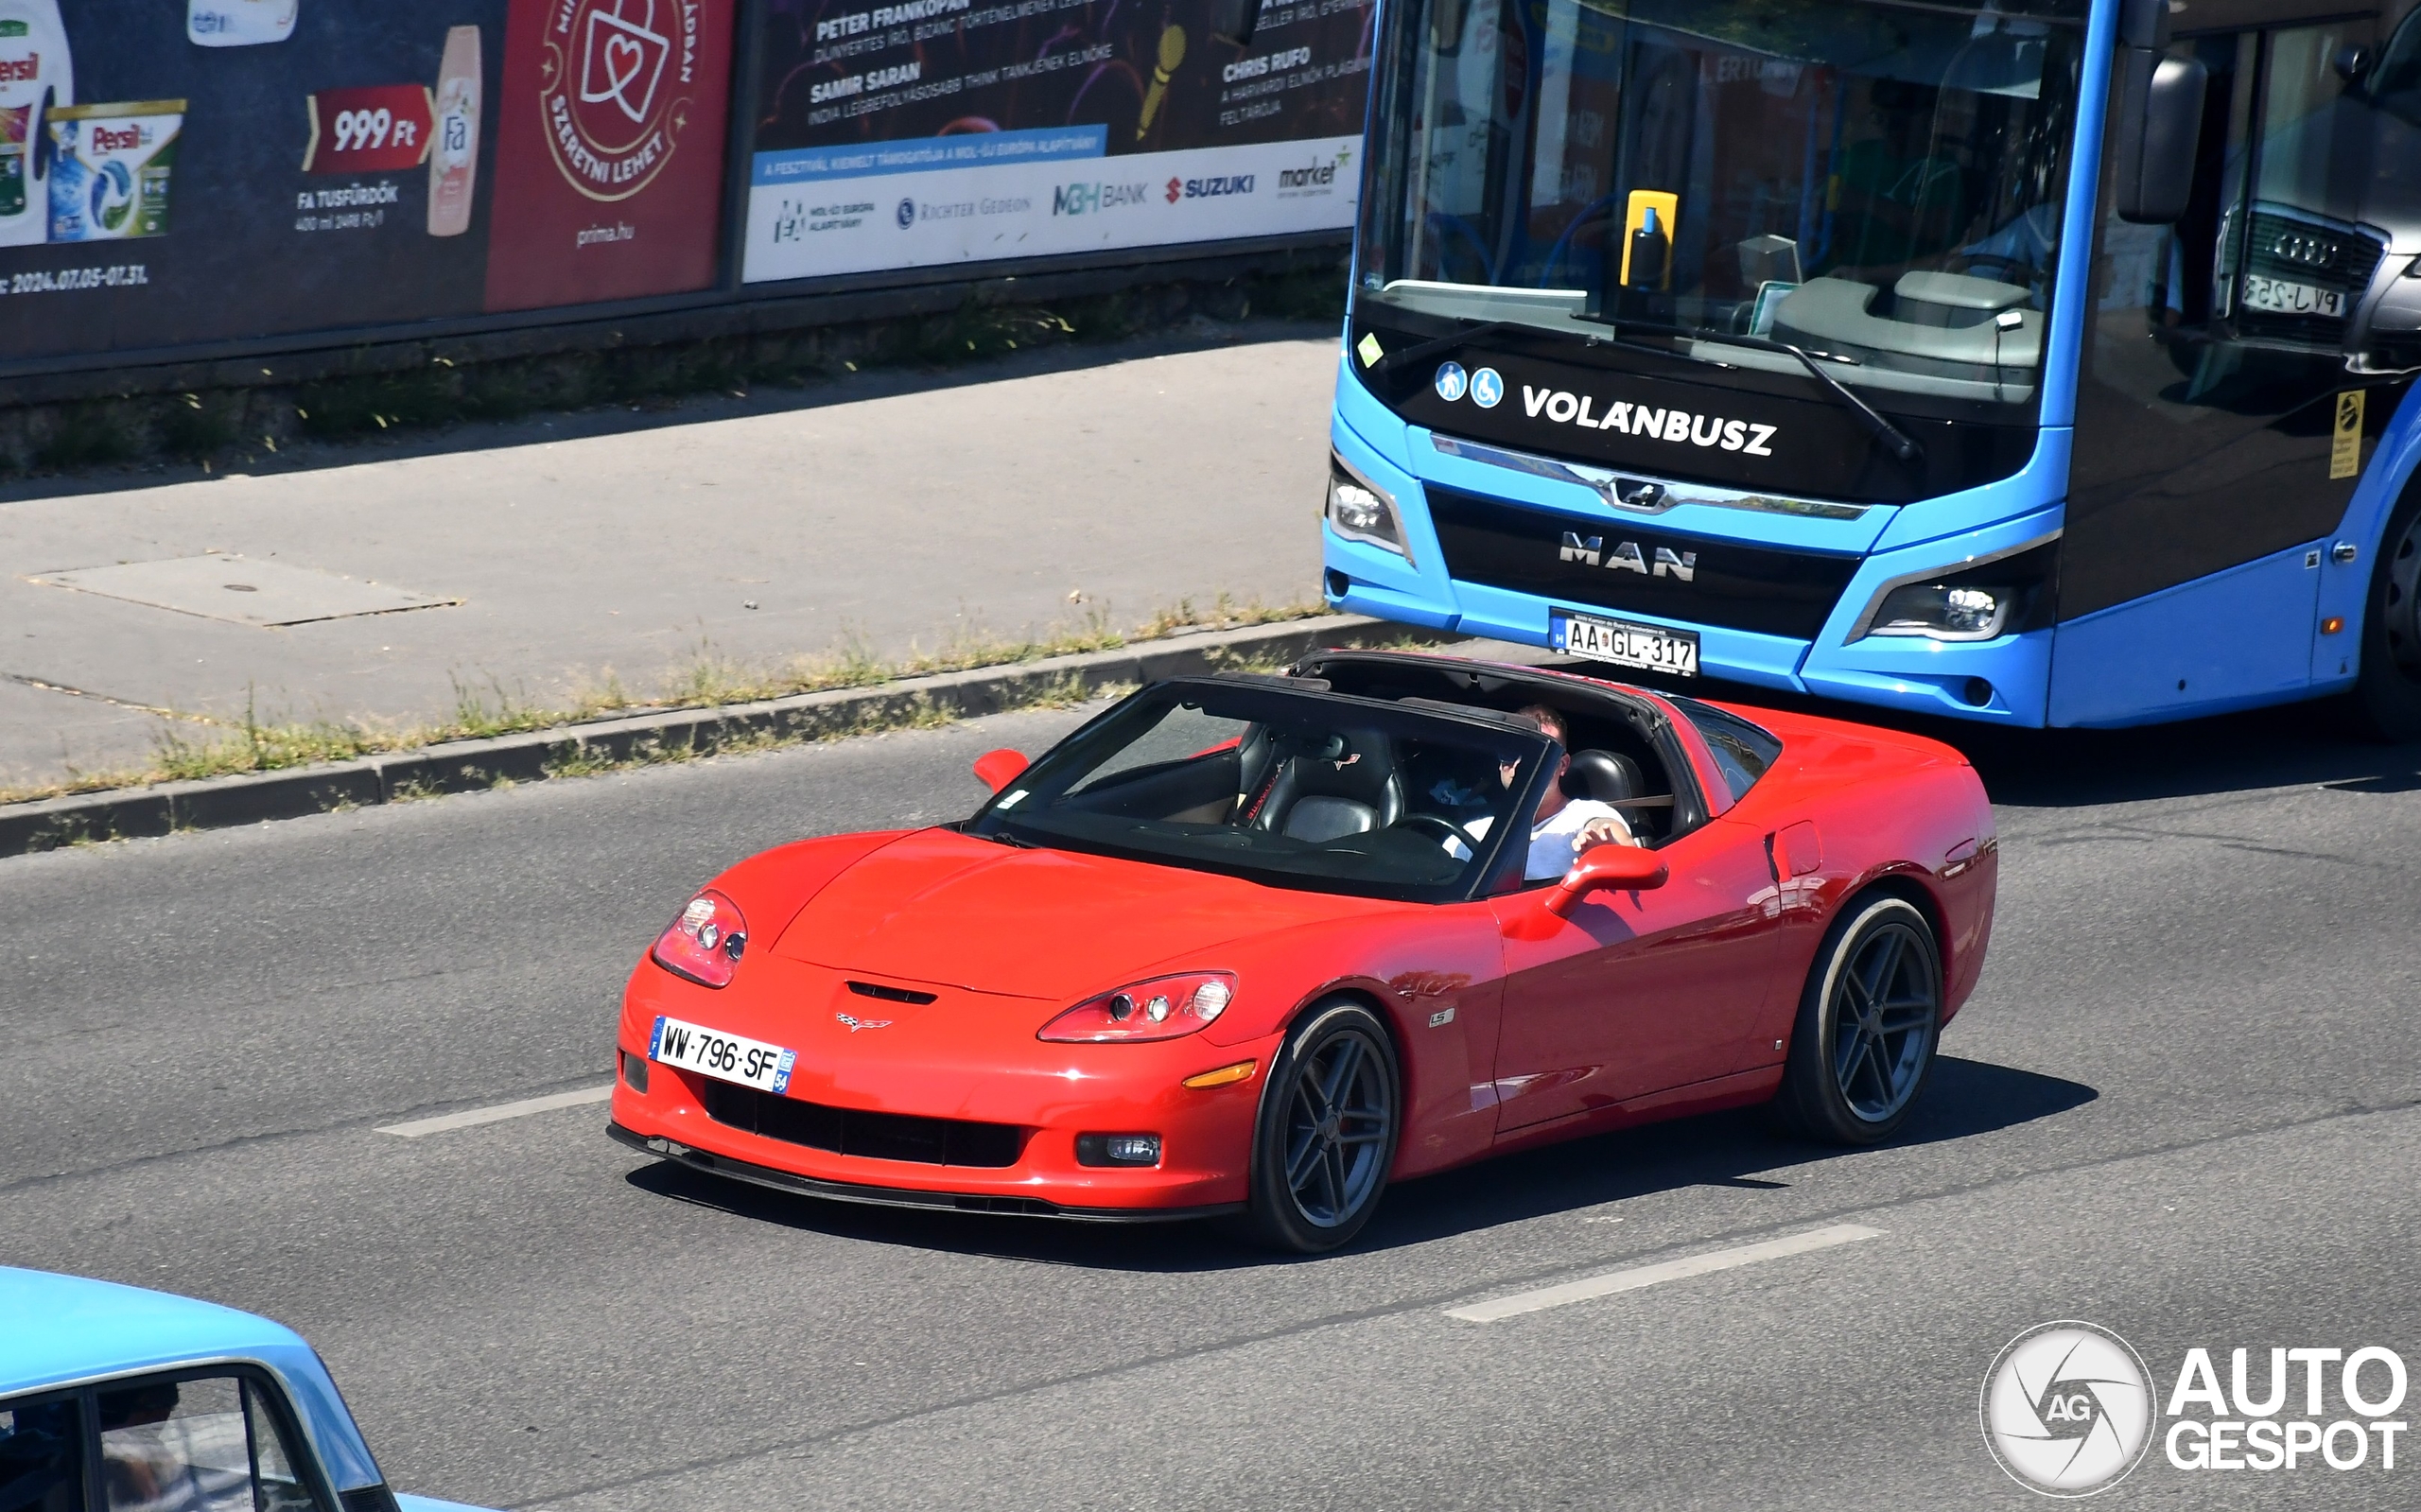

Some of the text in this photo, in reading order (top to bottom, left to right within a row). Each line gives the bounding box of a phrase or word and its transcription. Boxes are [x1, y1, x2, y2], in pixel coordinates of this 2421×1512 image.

[816, 12, 869, 42] PETER
[1223, 46, 1311, 82] CHRIS RUFO
[808, 106, 842, 126] INDIA
[964, 68, 1000, 90] THINK
[1068, 43, 1113, 67] ELNÖKE
[810, 61, 921, 104] SAMIR SARAN
[93, 124, 140, 151] Persil
[334, 108, 417, 152] 999 Ft
[444, 115, 466, 152] Fa
[551, 95, 663, 183] SZERETNI LEHET
[1185, 174, 1255, 199] SUZUKI
[1279, 156, 1336, 189] market
[297, 192, 315, 210] FA
[1053, 182, 1149, 217] MBH BANK
[576, 220, 636, 250] prima.hu
[1522, 385, 1778, 457] VOLÁNBUSZ
[1559, 531, 1698, 582] MAN
[1555, 634, 1564, 645] H
[652, 1041, 658, 1051] F
[774, 1073, 788, 1090] 54
